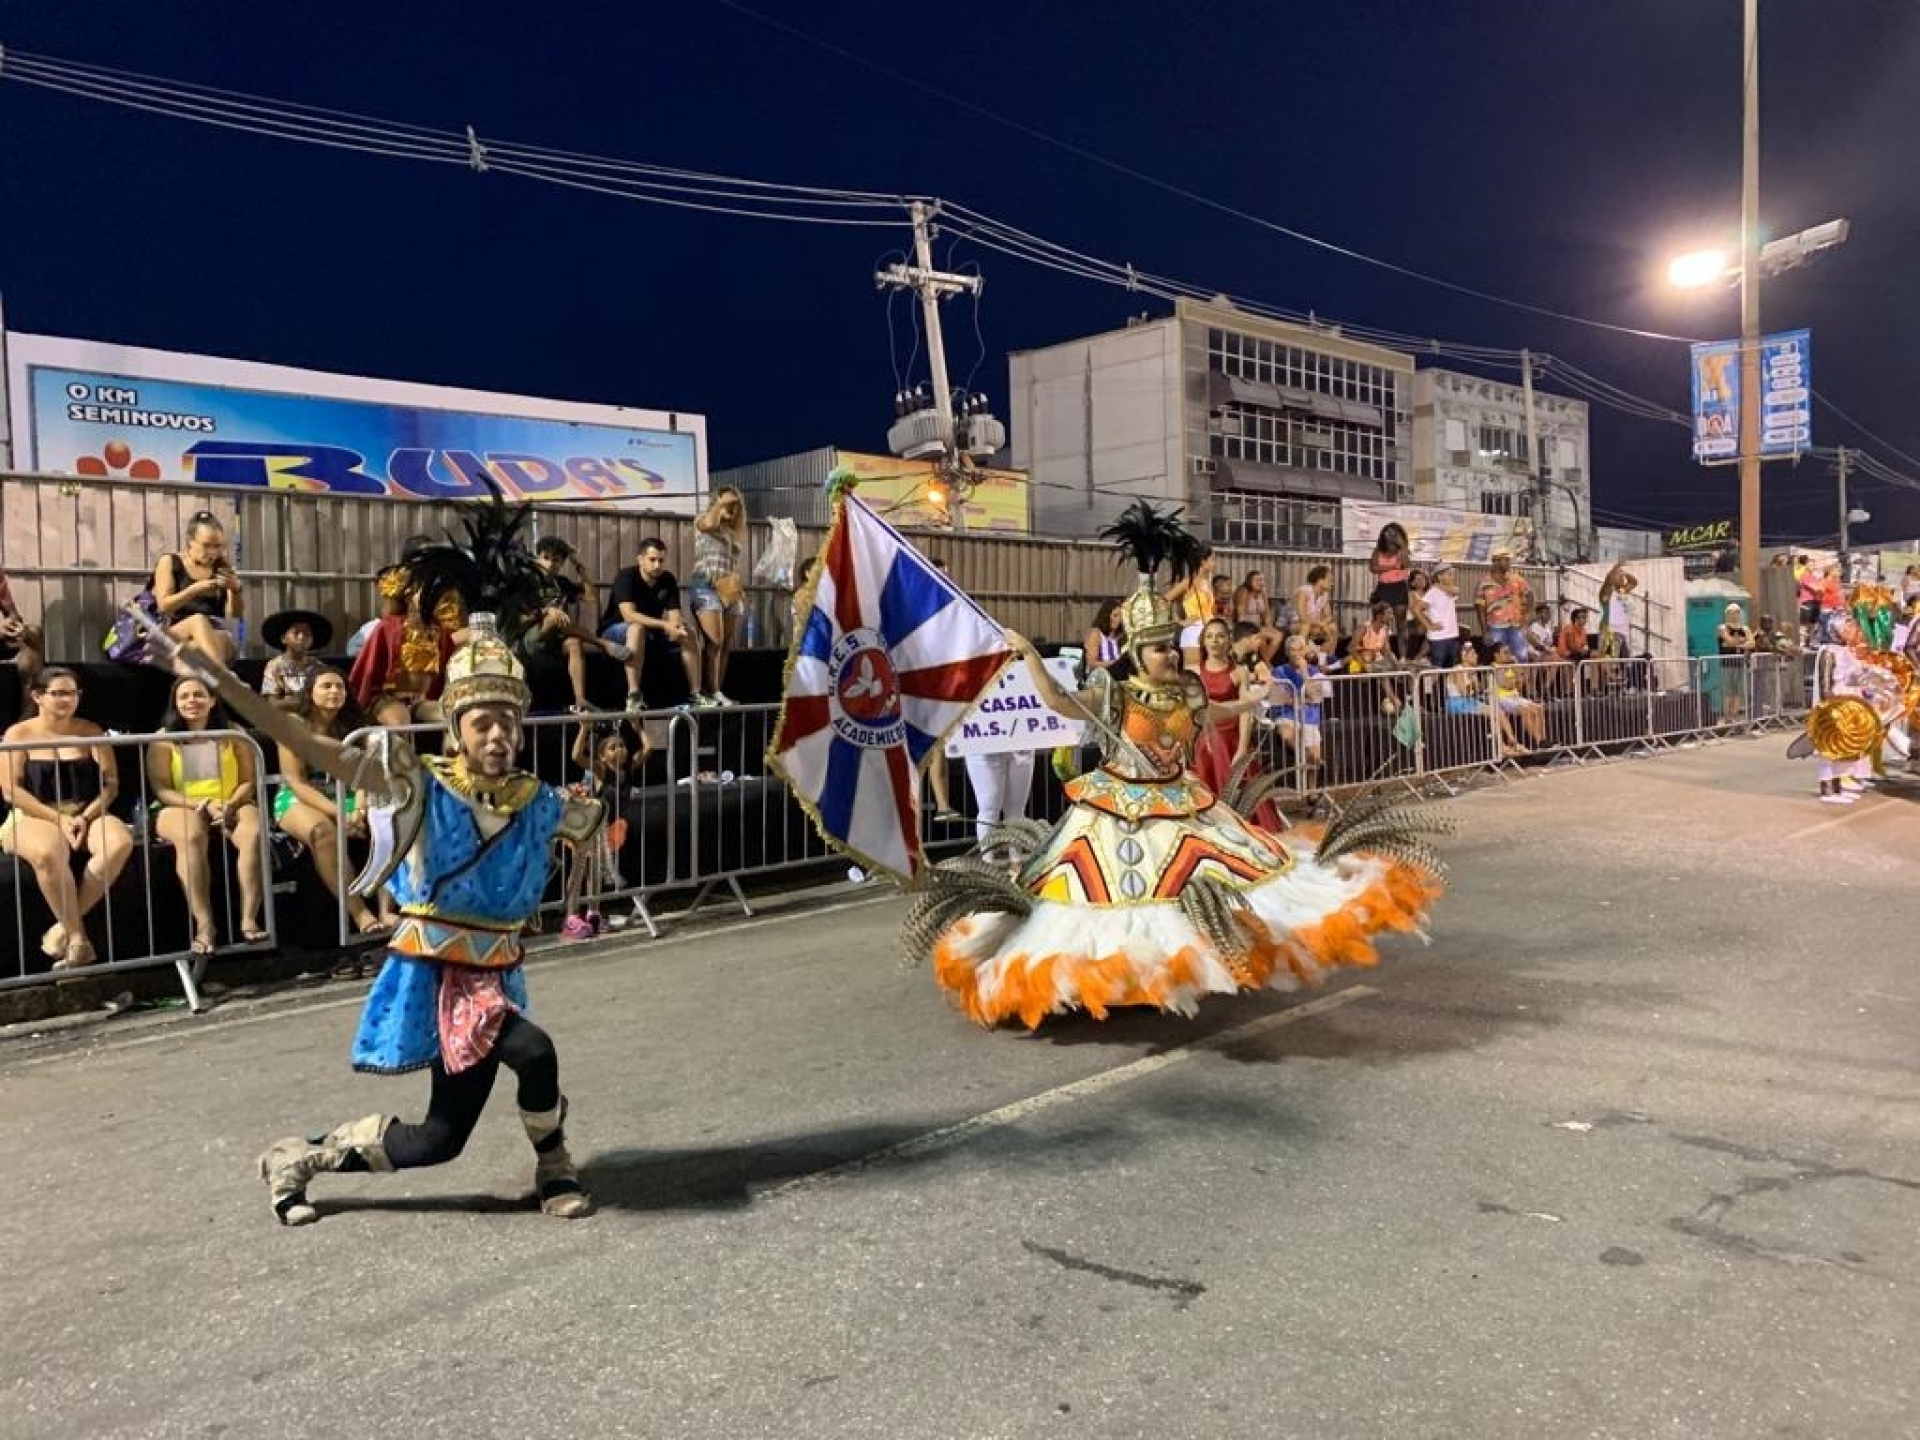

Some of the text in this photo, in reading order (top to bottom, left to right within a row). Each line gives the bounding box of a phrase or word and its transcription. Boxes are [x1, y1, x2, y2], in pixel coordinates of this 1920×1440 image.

[97, 386, 138, 405] KM
[69, 404, 215, 432] SEMINOVOS
[980, 695, 1041, 713] CASAL
